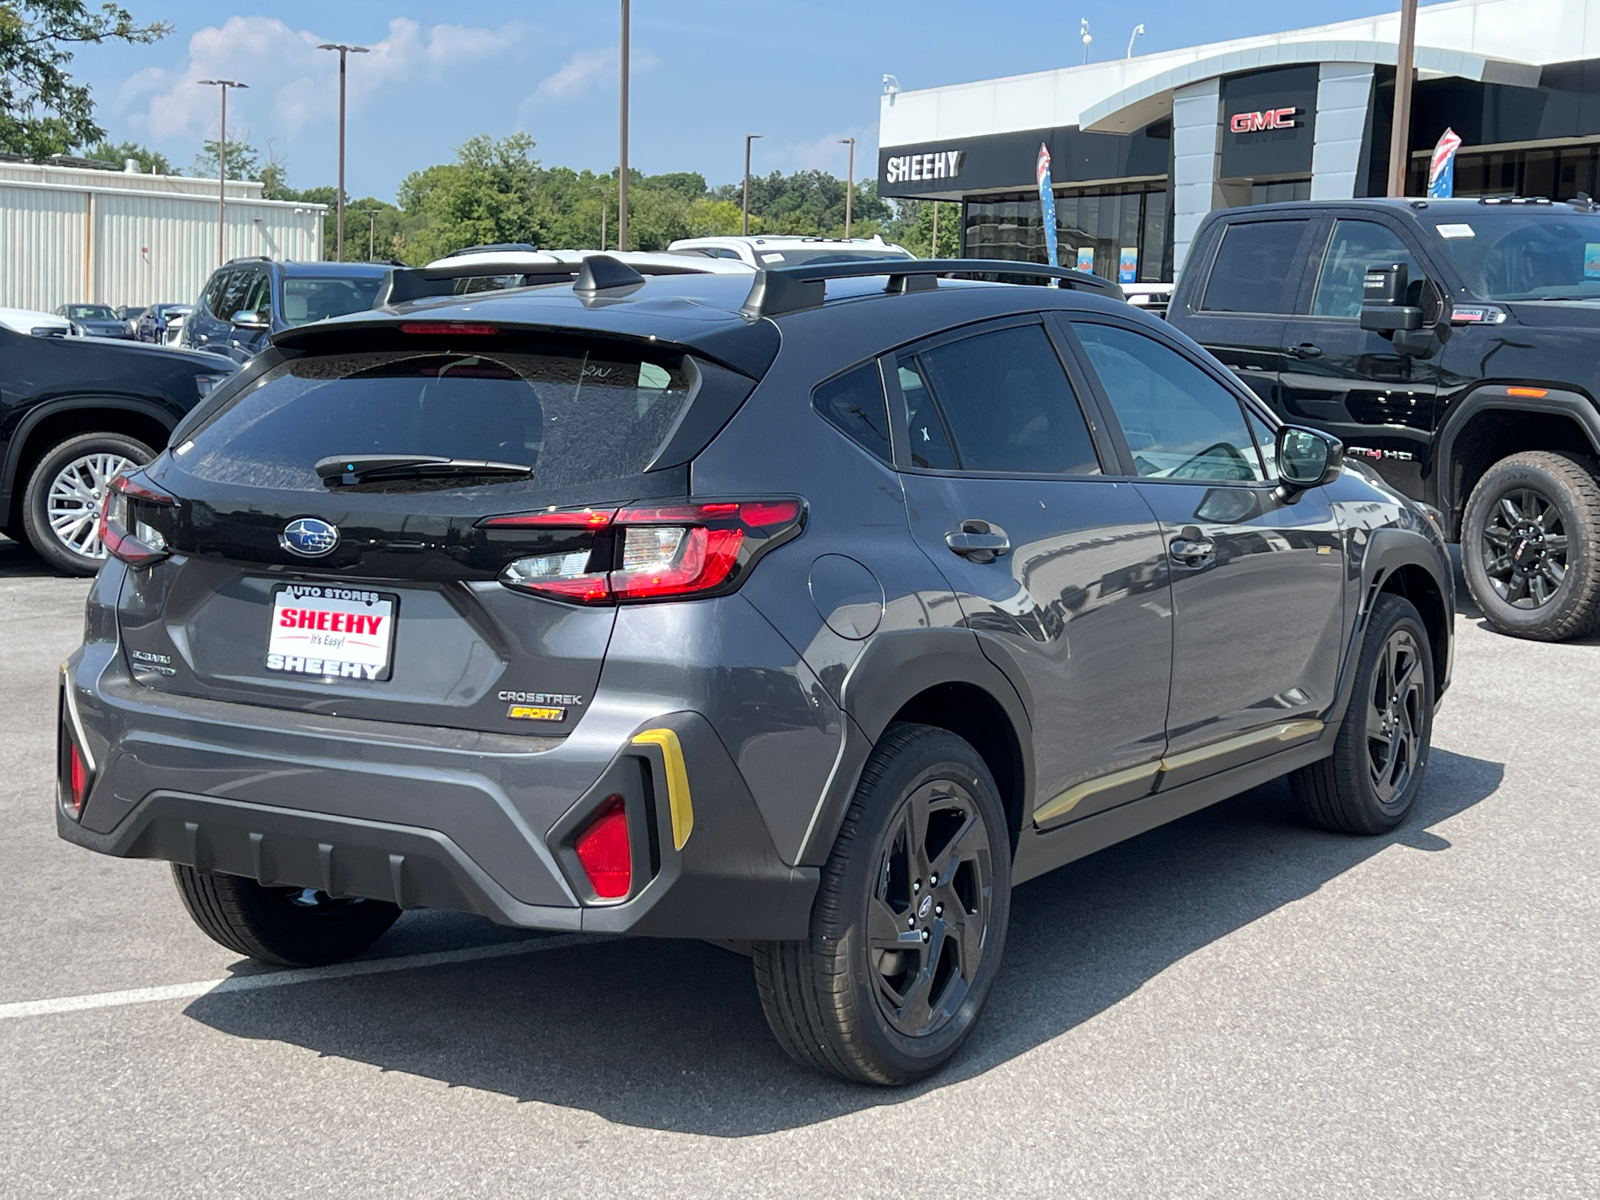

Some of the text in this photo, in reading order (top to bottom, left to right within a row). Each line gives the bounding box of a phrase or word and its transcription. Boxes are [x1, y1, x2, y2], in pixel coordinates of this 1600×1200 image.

[1231, 107, 1296, 133] GMC
[886, 150, 961, 184] SHEEHY
[285, 585, 379, 602] AUTO STORES
[280, 608, 383, 635] SHEEHY
[310, 633, 346, 650] It's Easy!
[266, 654, 384, 680] SHEEHY
[497, 690, 583, 705] CROSSTREK
[510, 706, 560, 719] SPORT
